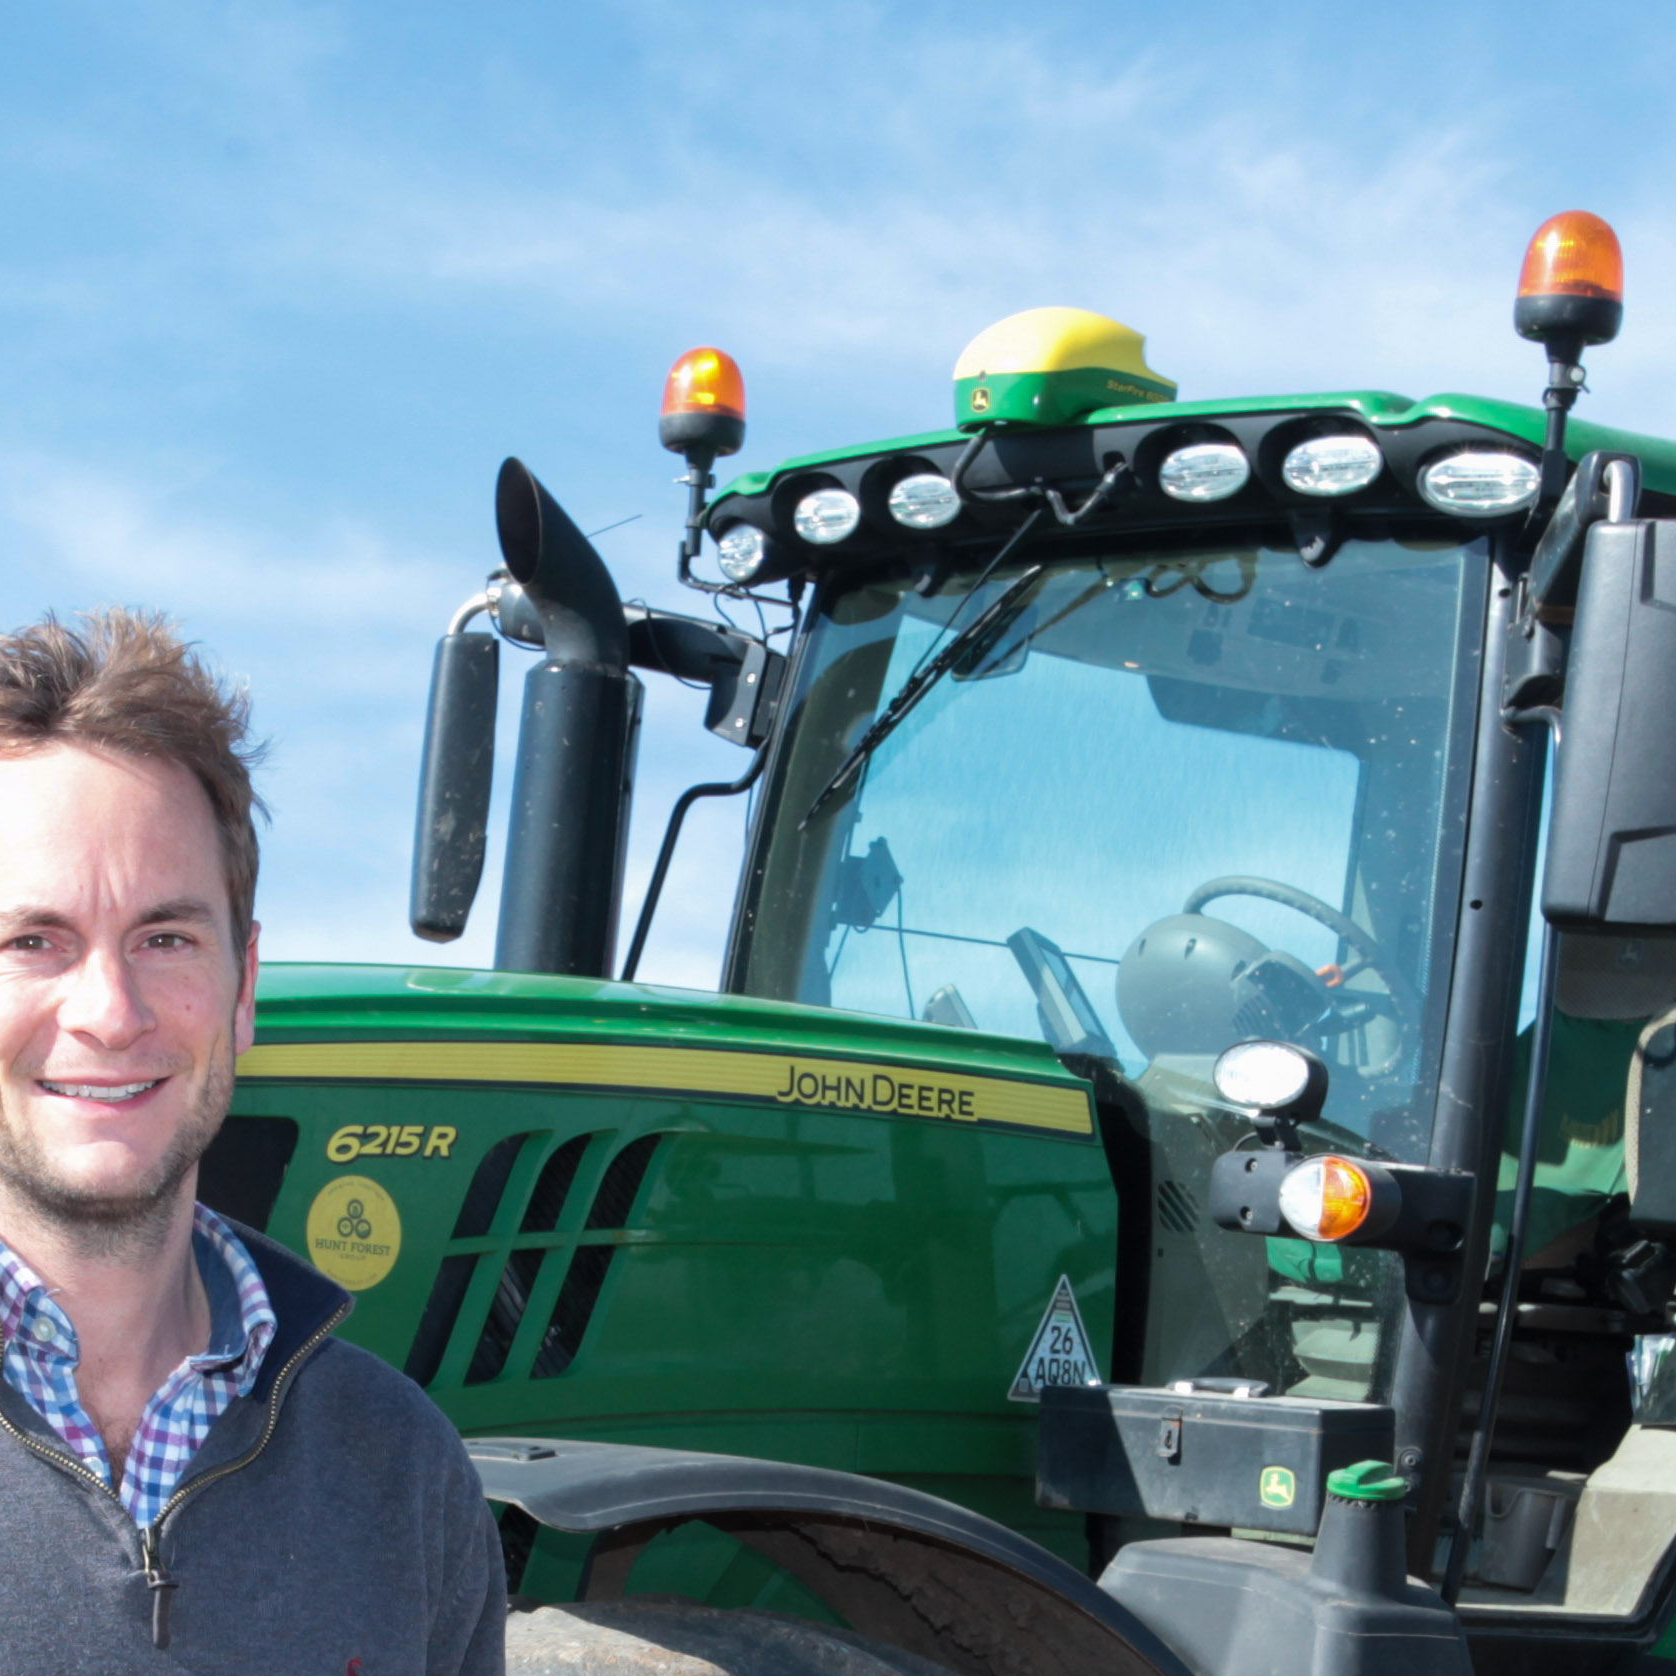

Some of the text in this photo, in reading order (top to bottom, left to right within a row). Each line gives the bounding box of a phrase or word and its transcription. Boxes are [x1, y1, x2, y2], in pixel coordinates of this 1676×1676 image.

[777, 1065, 975, 1117] JOHN DEERE
[315, 1238, 391, 1256] HUNT FOREST
[1049, 1325, 1073, 1355] 26
[1035, 1356, 1086, 1386] AQ8N
